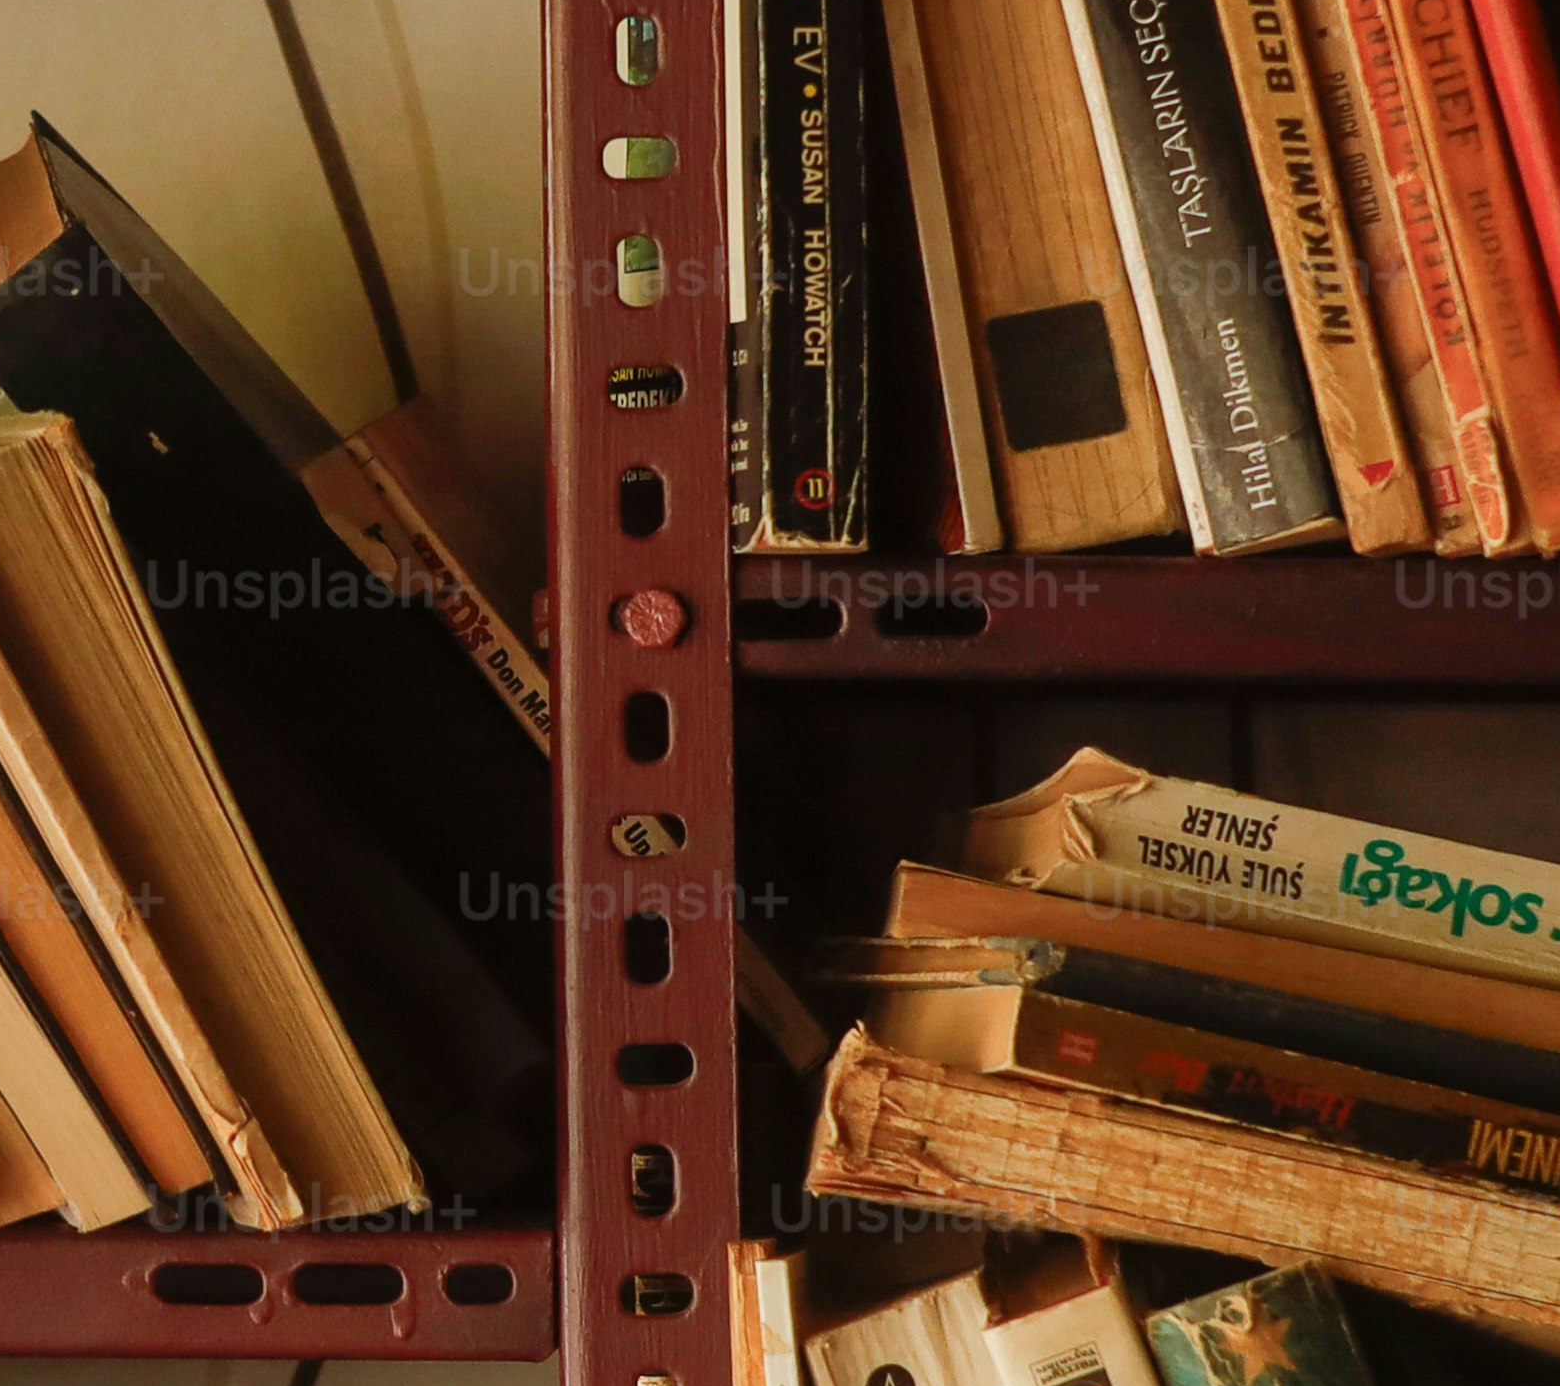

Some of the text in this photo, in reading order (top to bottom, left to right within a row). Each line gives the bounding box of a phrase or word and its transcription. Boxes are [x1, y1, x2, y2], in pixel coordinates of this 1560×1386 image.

[791, 26, 819, 74] EV
[800, 110, 823, 205] SUSAN
[803, 229, 828, 367] HOWATCH
[1216, 316, 1275, 513] Hilal Dikmen
[1136, 835, 1303, 901] ŞULE YÜKSEL
[1182, 805, 1280, 851] ŞENLER
